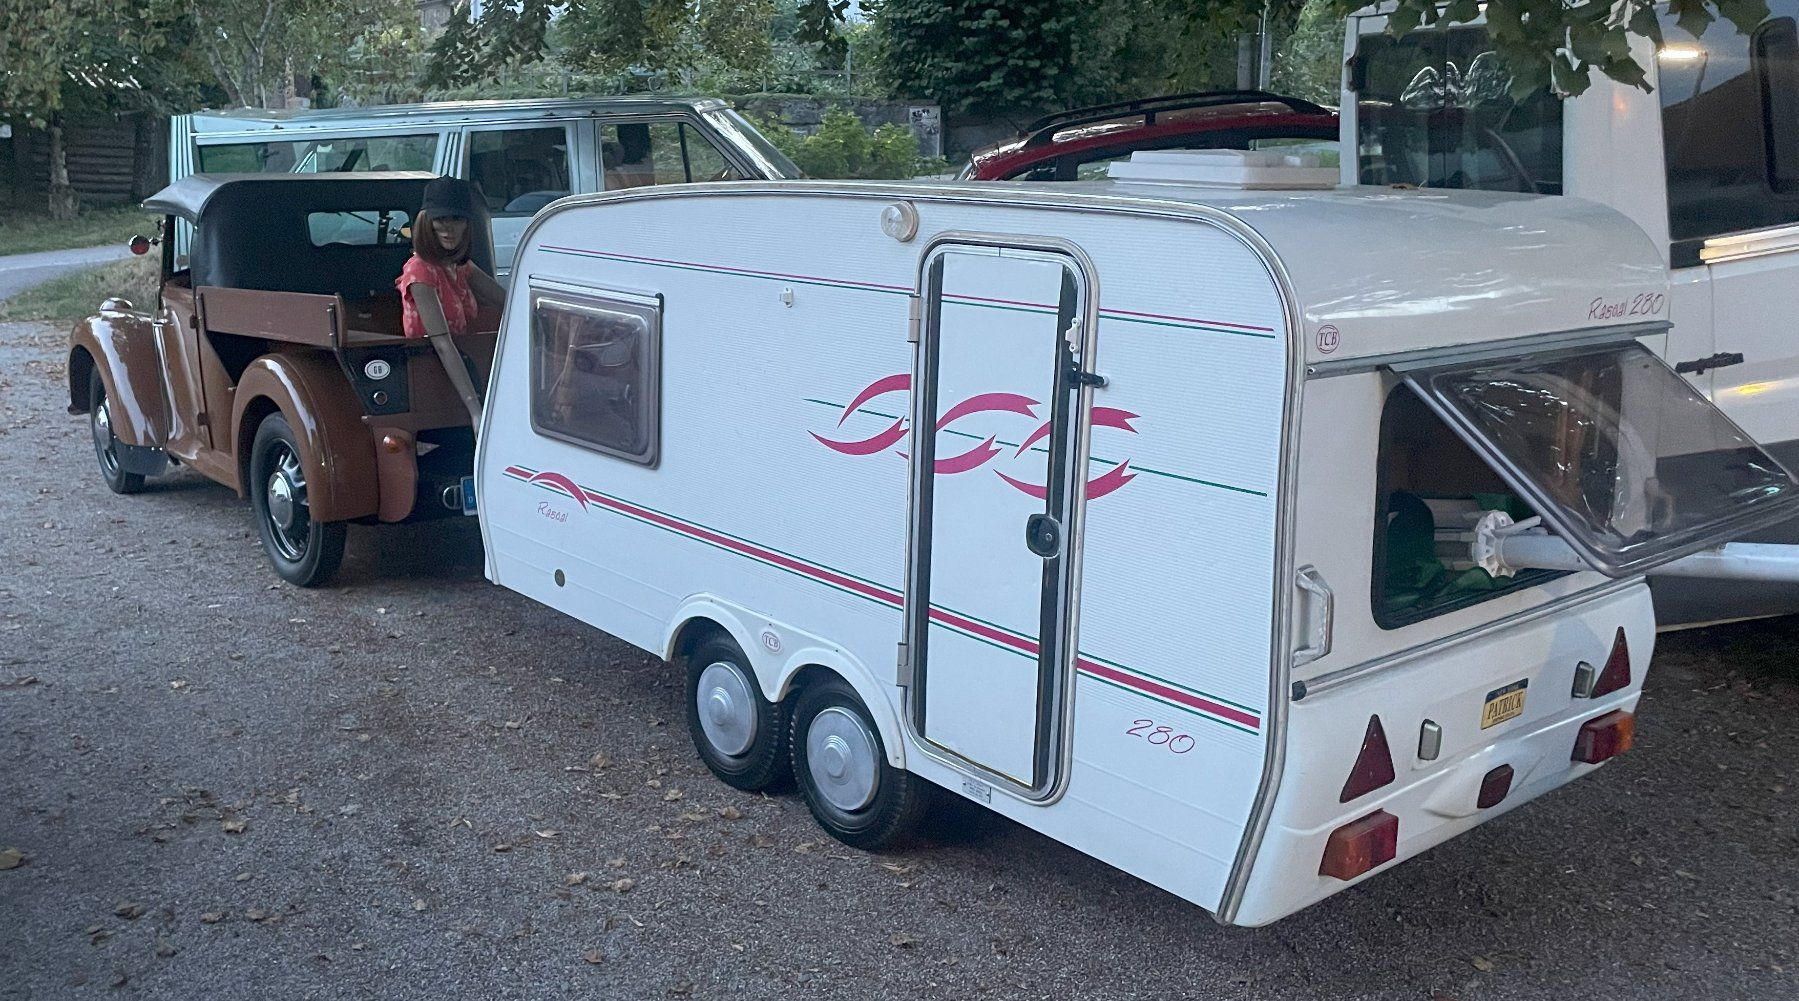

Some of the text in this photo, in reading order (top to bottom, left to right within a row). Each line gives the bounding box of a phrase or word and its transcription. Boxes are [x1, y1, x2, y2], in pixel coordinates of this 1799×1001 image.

[1628, 293, 1665, 316] 280
[1319, 331, 1338, 347] TCB
[373, 365, 383, 375] GB
[1487, 691, 1523, 719] PATRICK
[1126, 719, 1195, 754] 280
